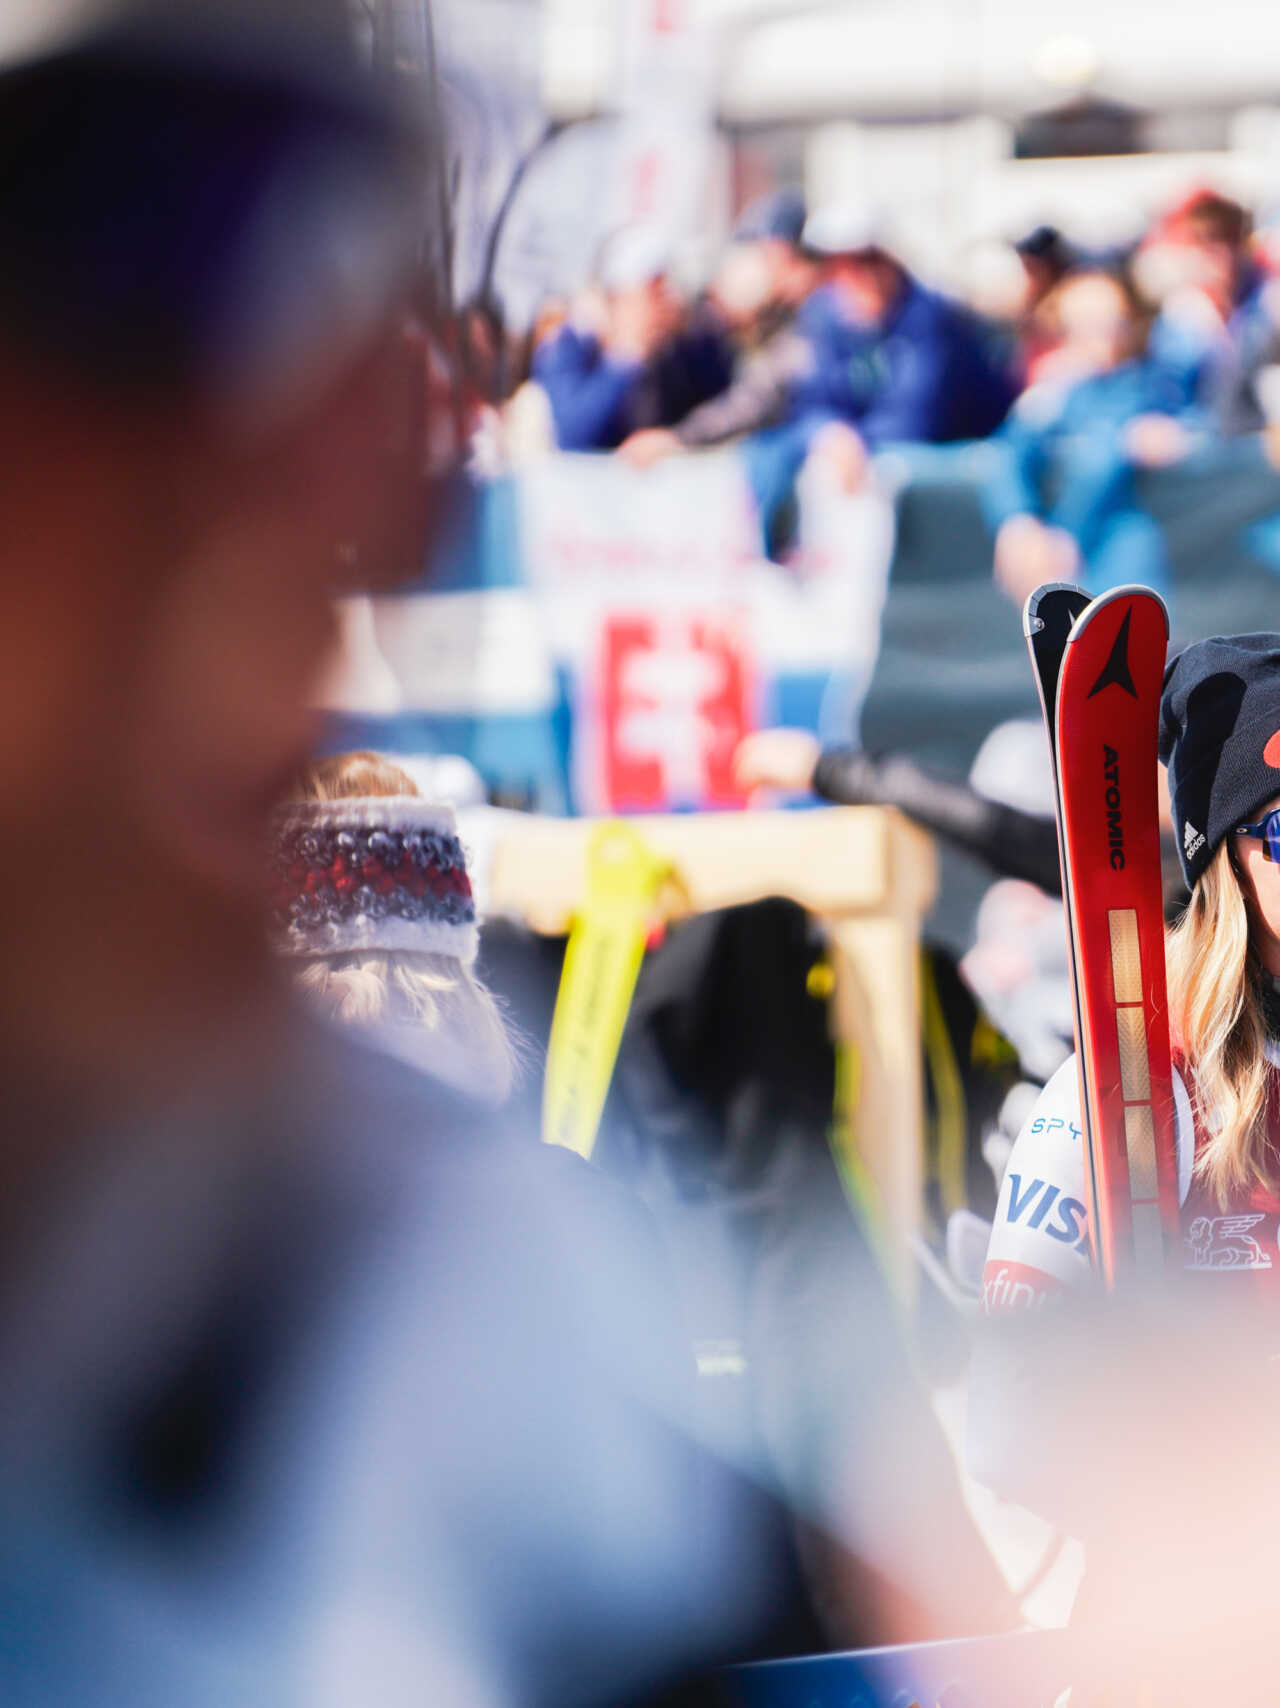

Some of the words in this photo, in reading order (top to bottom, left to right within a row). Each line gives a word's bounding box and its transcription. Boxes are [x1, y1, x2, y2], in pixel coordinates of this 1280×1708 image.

[1103, 744, 1125, 871] ATOMIC
[1186, 833, 1206, 860] adidas
[1031, 1118, 1082, 1140] SPY
